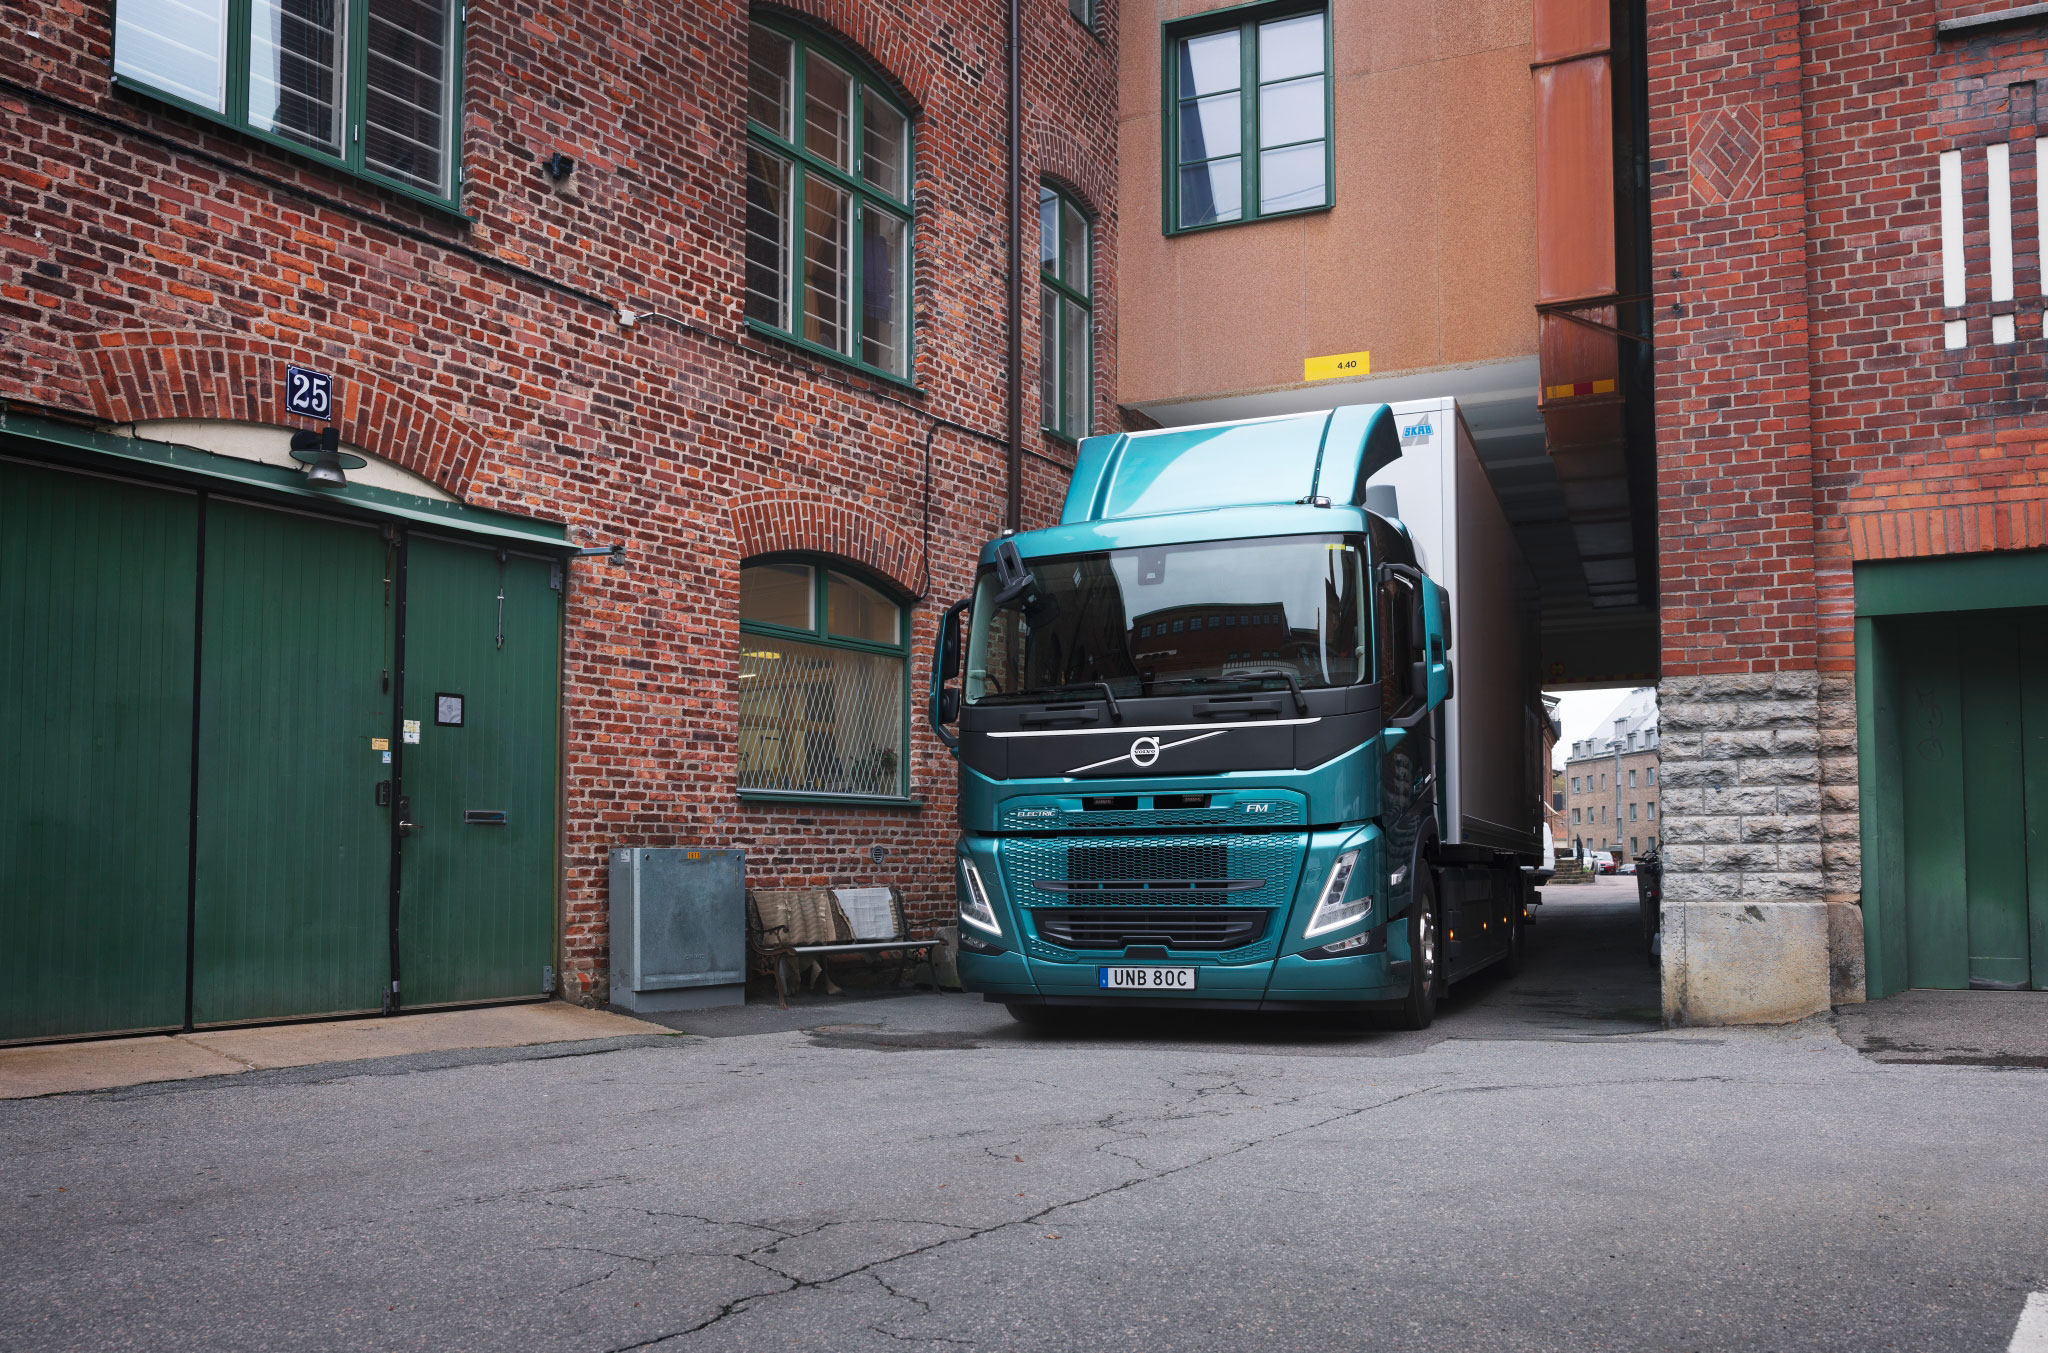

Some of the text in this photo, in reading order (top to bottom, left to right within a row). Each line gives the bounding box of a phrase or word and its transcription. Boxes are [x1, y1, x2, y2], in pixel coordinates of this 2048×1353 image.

[293, 374, 328, 412] 25
[1404, 425, 1432, 437] SKAB
[1246, 804, 1269, 813] FM
[1114, 969, 1147, 986] UNB
